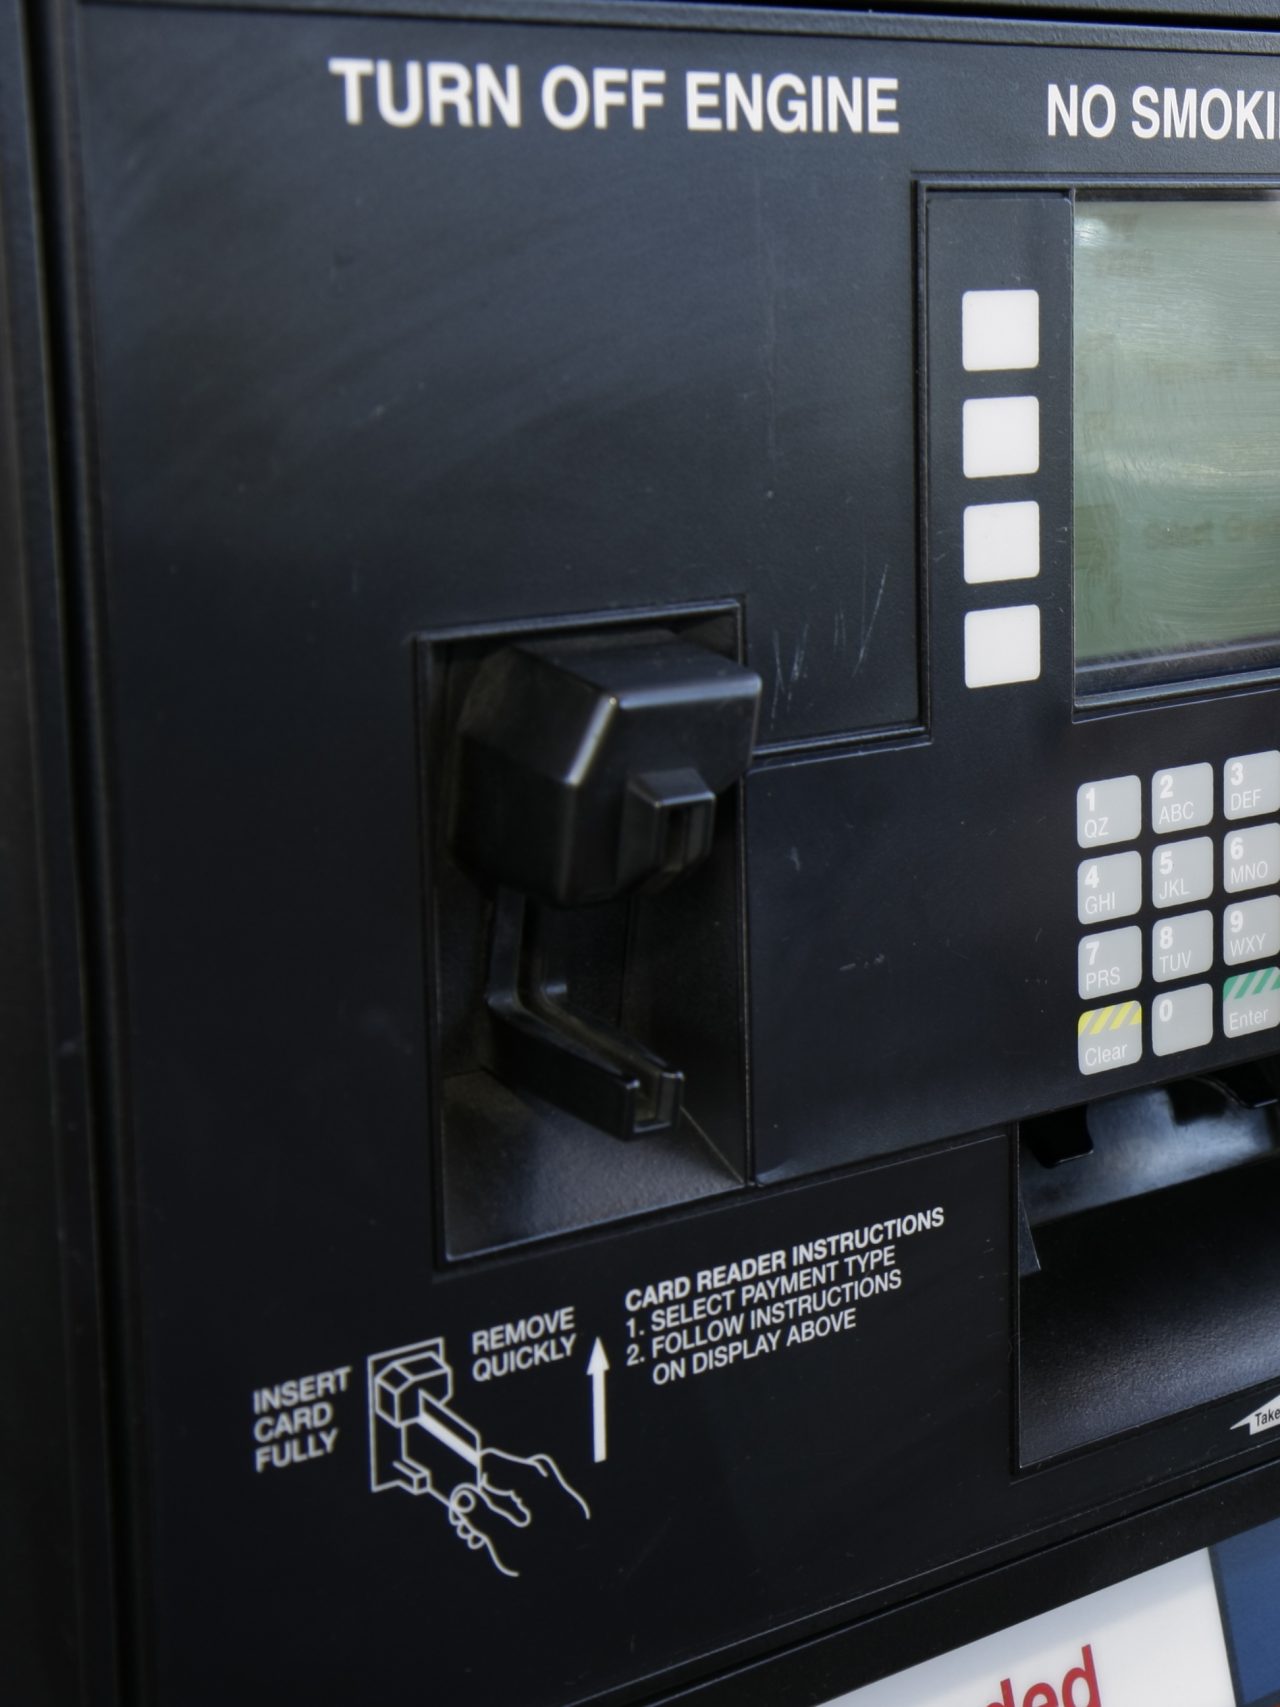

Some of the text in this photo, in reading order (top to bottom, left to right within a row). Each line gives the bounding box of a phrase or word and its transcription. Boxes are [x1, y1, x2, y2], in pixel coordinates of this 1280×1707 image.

[328, 57, 899, 134] TURN OFF ENGINE
[1047, 83, 1117, 138] NO
[1230, 761, 1244, 786] 3
[1159, 774, 1174, 800] 2
[1085, 787, 1097, 813] 1
[1230, 788, 1262, 812] DEF
[1158, 801, 1195, 825] ABC
[1084, 817, 1109, 840] QZ
[1230, 836, 1244, 860] 6
[1159, 850, 1173, 875] 5
[1230, 861, 1268, 884] MNO
[1084, 864, 1100, 889] 4
[1158, 877, 1190, 900] JKL
[1085, 892, 1116, 915] GHI
[1230, 910, 1244, 933] 9
[1159, 926, 1173, 950] 8
[1230, 933, 1267, 956] WXY
[1085, 941, 1100, 966] 7
[1159, 950, 1193, 973] TUV
[1085, 967, 1121, 991] PRS
[1159, 999, 1173, 1022] 0
[1229, 1006, 1269, 1032] Enter
[1085, 1042, 1128, 1067] Clear
[625, 1206, 945, 1311] CARD READER INSTRUCTIONS
[626, 1244, 896, 1338] 1. SELECT PAYMENT TYPE
[626, 1268, 902, 1366] 2. FOLLOW INSTRUCTIONS
[471, 1305, 575, 1355] REMOVE
[472, 1332, 577, 1382] QUICKLY
[652, 1307, 857, 1385] ON DISPLAY ABOVE
[253, 1364, 353, 1415] INSERT
[253, 1401, 334, 1443] CARD
[1254, 1408, 1280, 1427] Take
[254, 1427, 339, 1474] FULLY
